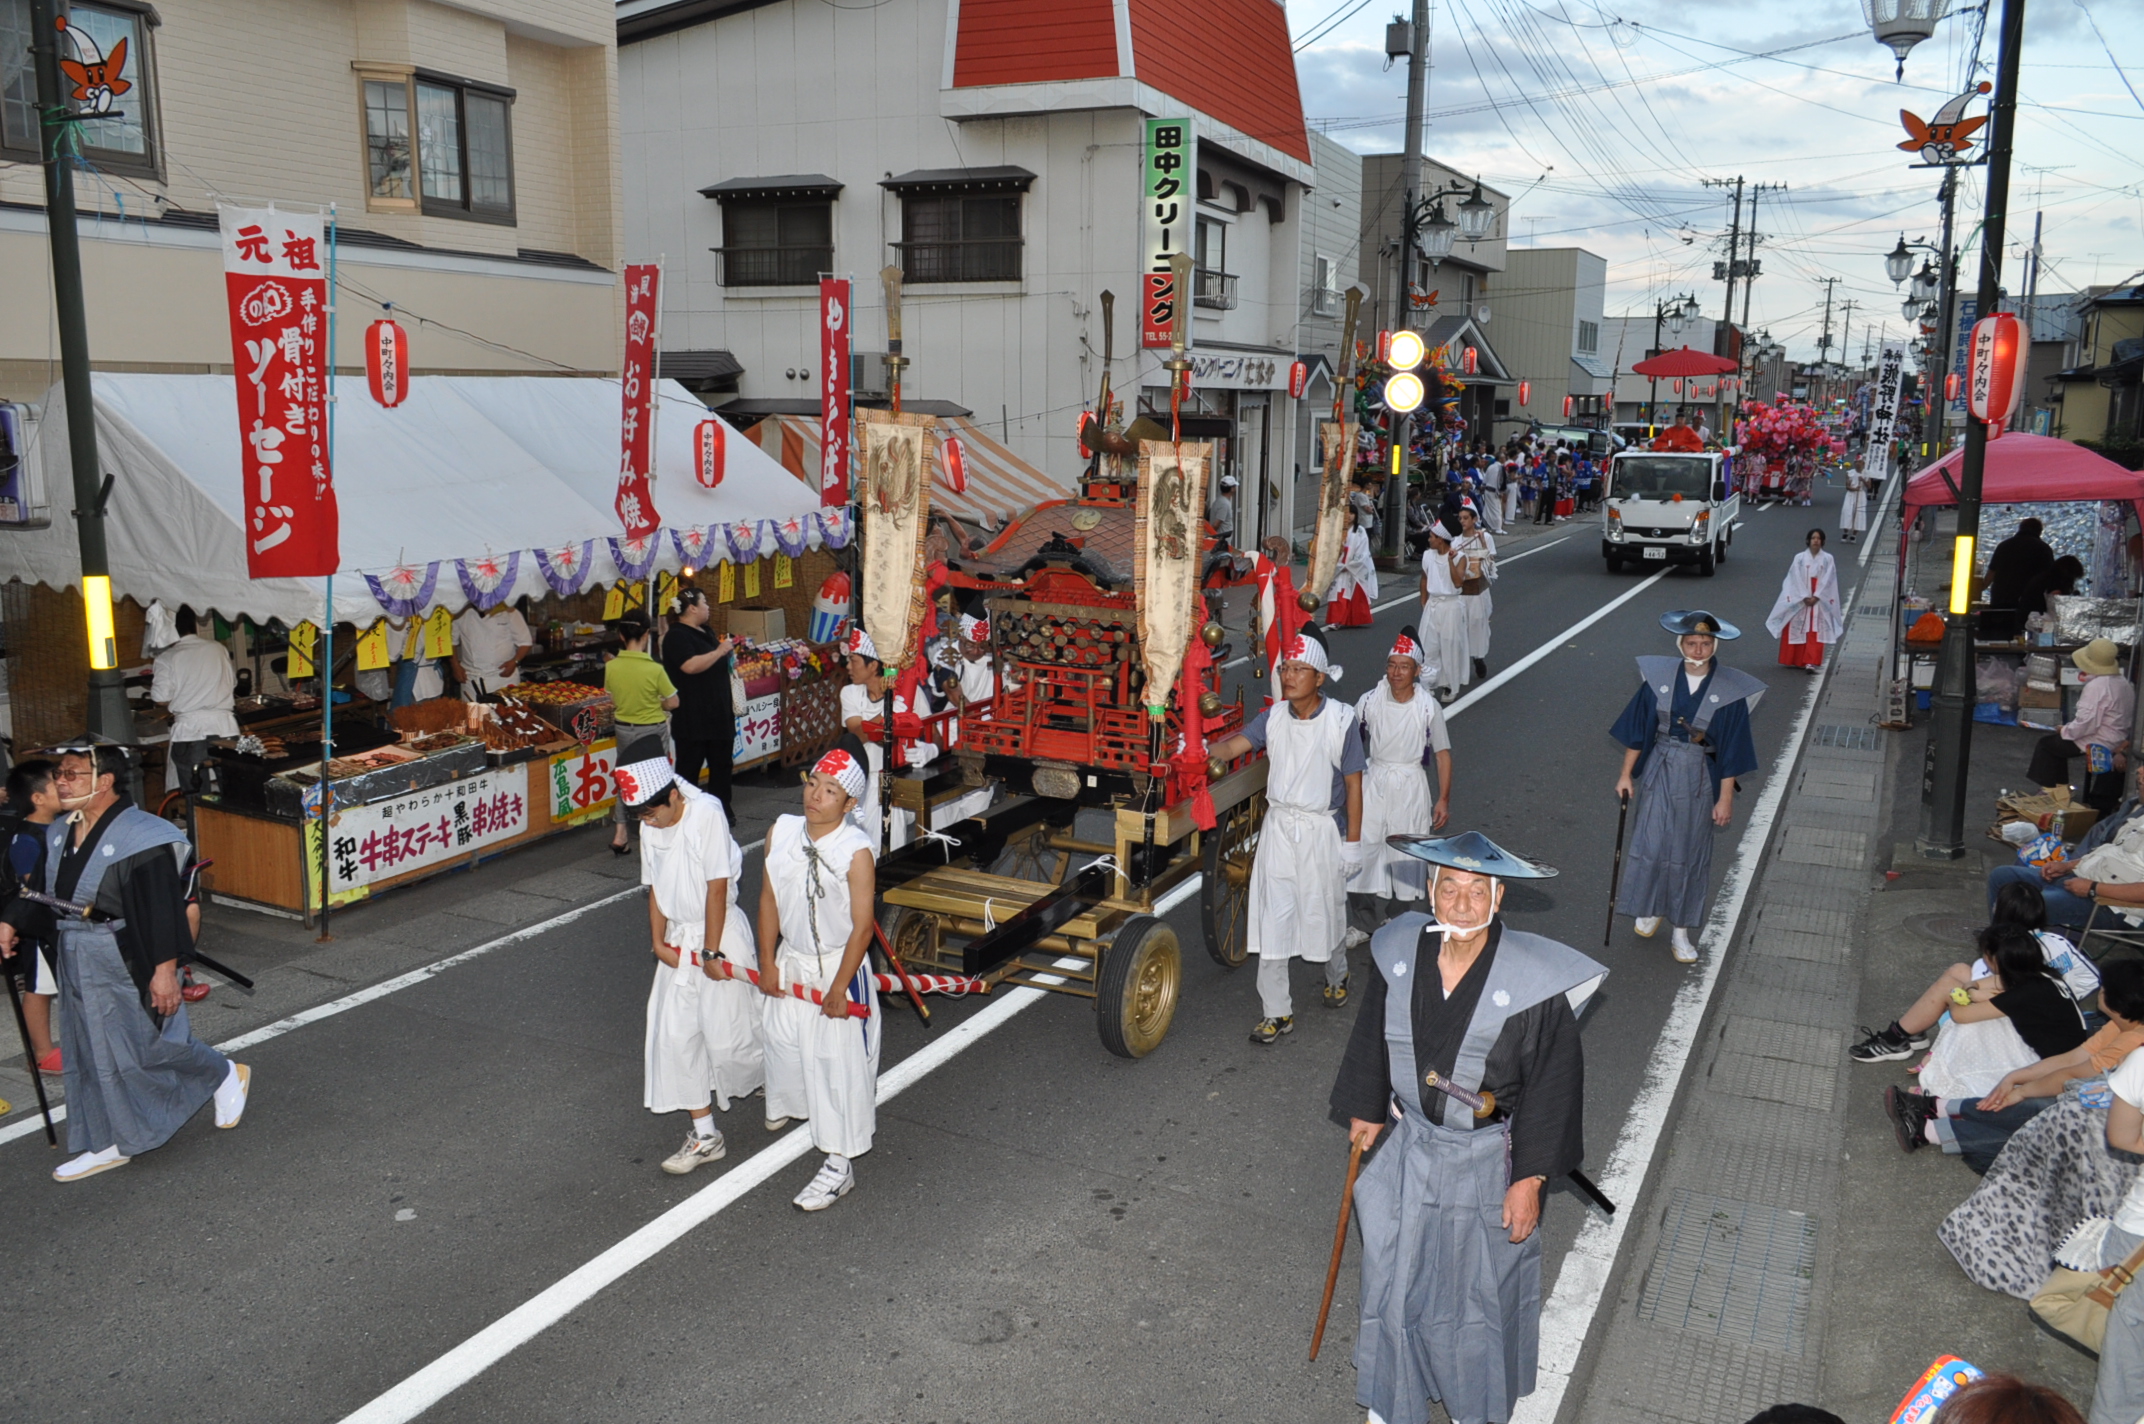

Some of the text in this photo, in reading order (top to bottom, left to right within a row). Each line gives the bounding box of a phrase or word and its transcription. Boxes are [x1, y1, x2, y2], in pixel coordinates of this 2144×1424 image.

[235, 224, 320, 270] 元祖
[381, 336, 395, 391] 中町々内会
[1145, 331, 1158, 341] TEL
[277, 327, 306, 435] 骨付き
[823, 296, 844, 491] やきそば
[1974, 333, 1991, 402] 中町々内会
[244, 337, 295, 556] ソーセージ
[620, 360, 650, 530] お好み焼
[703, 432, 713, 476] 中町々内会
[382, 778, 489, 819] 超やわらか十和田牛
[553, 758, 574, 819] 広島風
[1924, 744, 1936, 793] 六戸町
[333, 791, 523, 882] 和牛 牛串ステーキ 黒豚 串焼き
